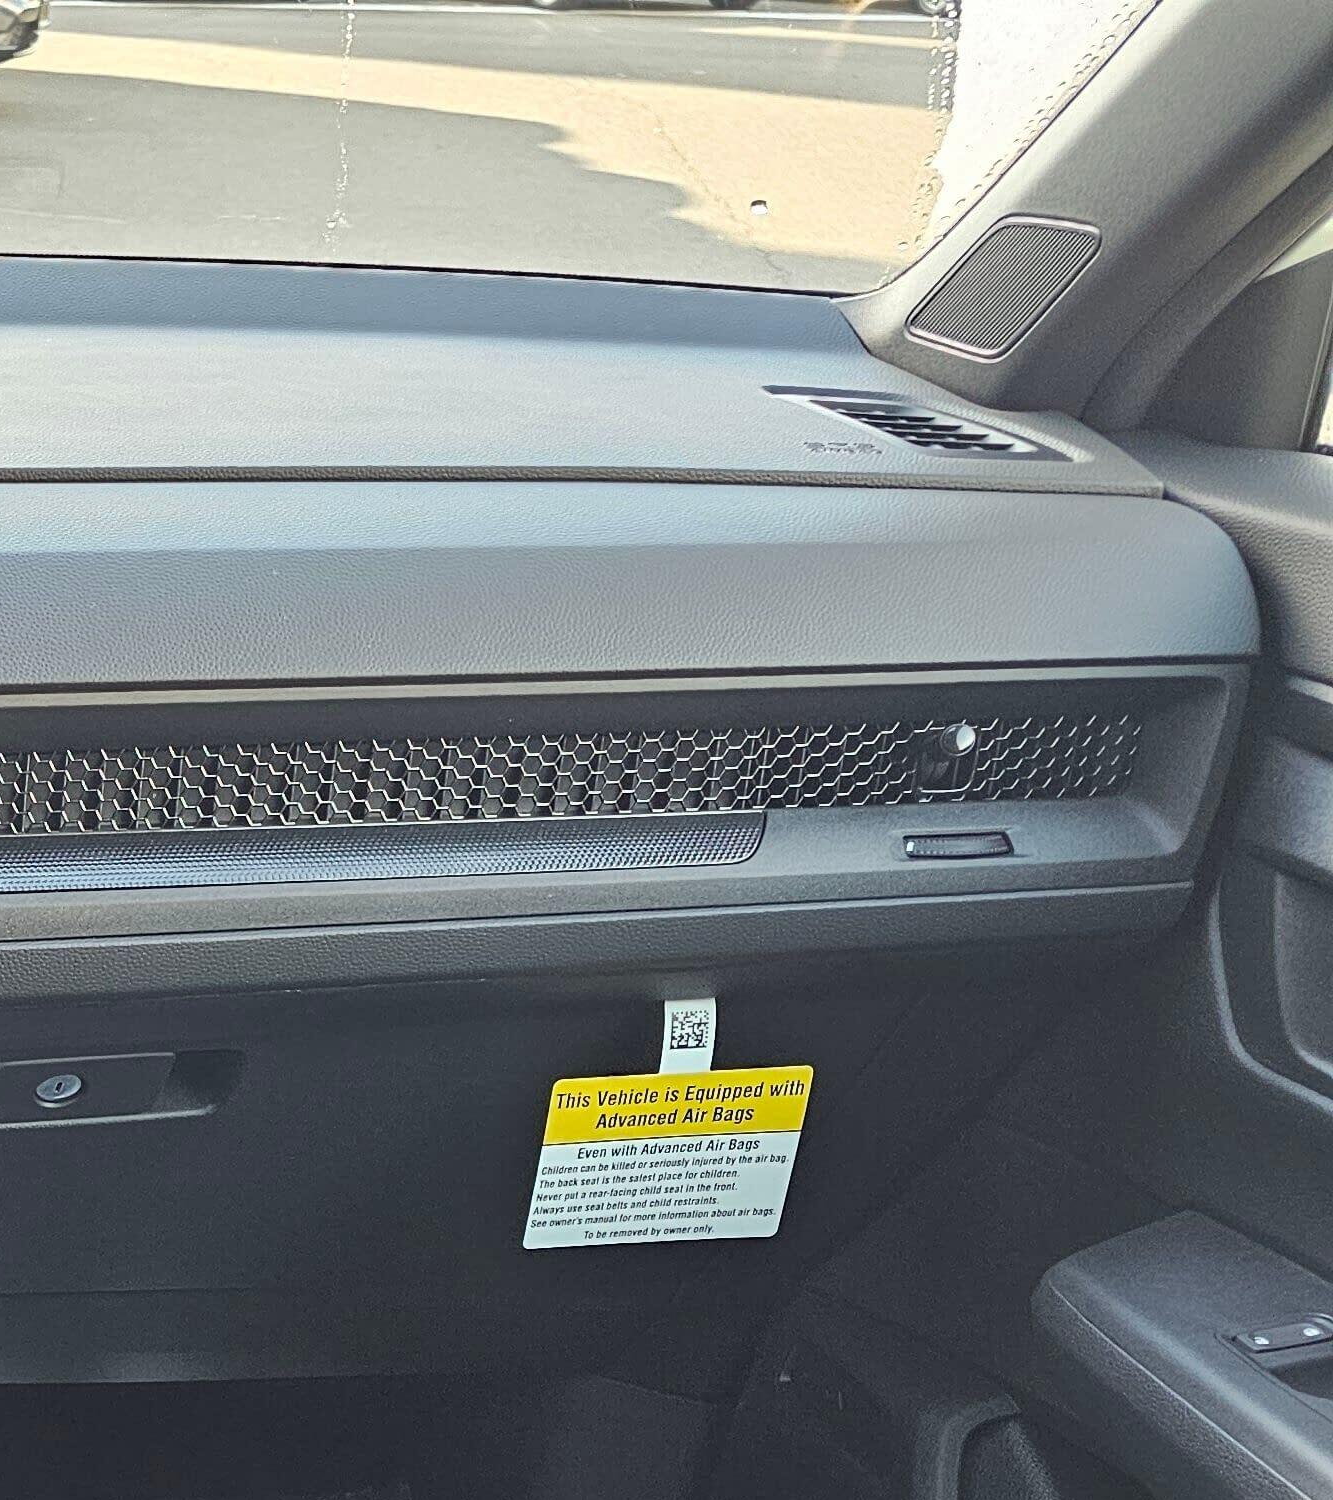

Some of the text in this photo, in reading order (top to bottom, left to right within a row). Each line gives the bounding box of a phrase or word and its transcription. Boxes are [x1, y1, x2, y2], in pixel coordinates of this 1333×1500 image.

[556, 1079, 805, 1109] This Vehicle is Equipped with
[596, 1107, 754, 1129] Advanced Air Bags
[578, 1138, 760, 1159] Even with Advanced Air Bags
[541, 1153, 789, 1176] Children can be killed or seriously injured by the air bag.
[539, 1167, 740, 1188] The back seat is the safest place for children.
[536, 1192, 561, 1202] Never
[564, 1191, 579, 1202] put
[589, 1186, 637, 1200] rear-facing
[639, 1184, 662, 1195] child
[664, 1184, 683, 1194] seat
[685, 1183, 694, 1192] in
[696, 1182, 711, 1192] the
[713, 1181, 738, 1192] front.
[533, 1196, 719, 1216] Always use seat belts and child restraints.
[530, 1207, 776, 1228] See owner's manual for more information about air bags.
[584, 1225, 714, 1240] To be removed by owner only.
